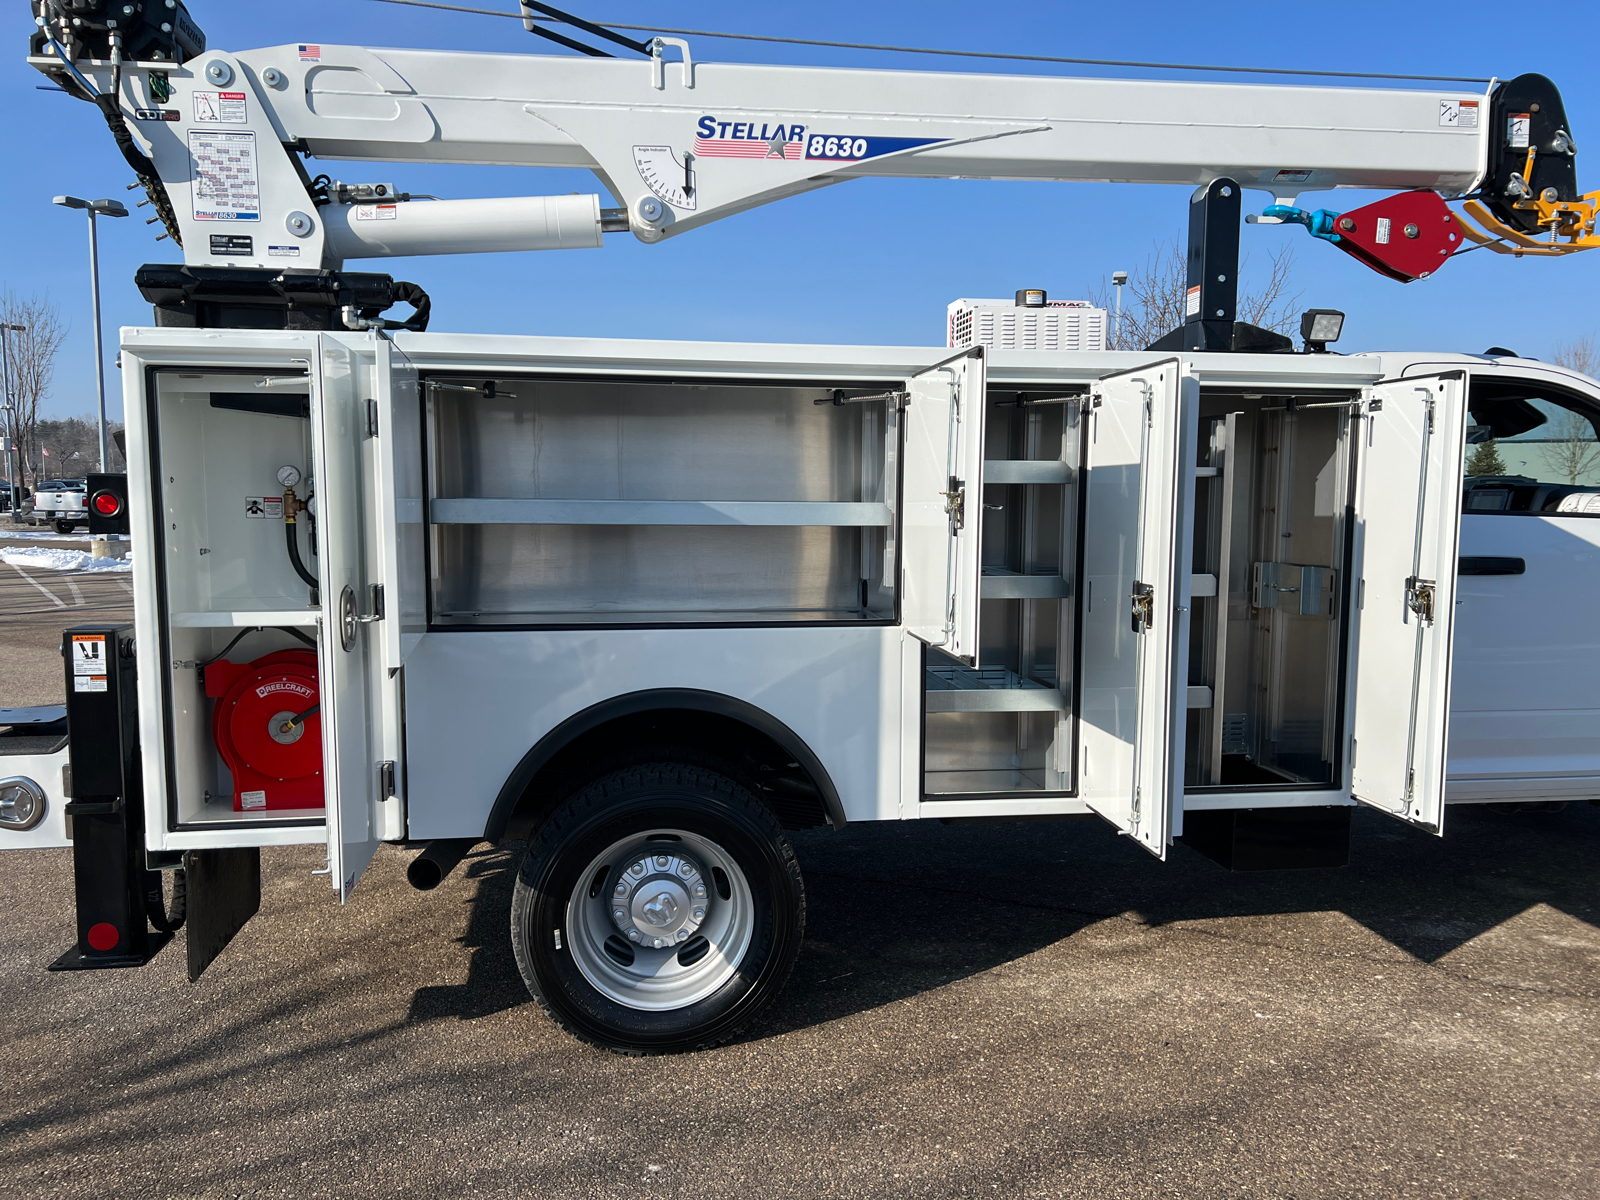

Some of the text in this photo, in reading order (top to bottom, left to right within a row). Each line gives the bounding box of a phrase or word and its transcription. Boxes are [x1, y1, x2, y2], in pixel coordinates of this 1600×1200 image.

[696, 115, 805, 142] STELLAR
[809, 136, 868, 158] 8630
[265, 683, 311, 696] REELCRAFT
